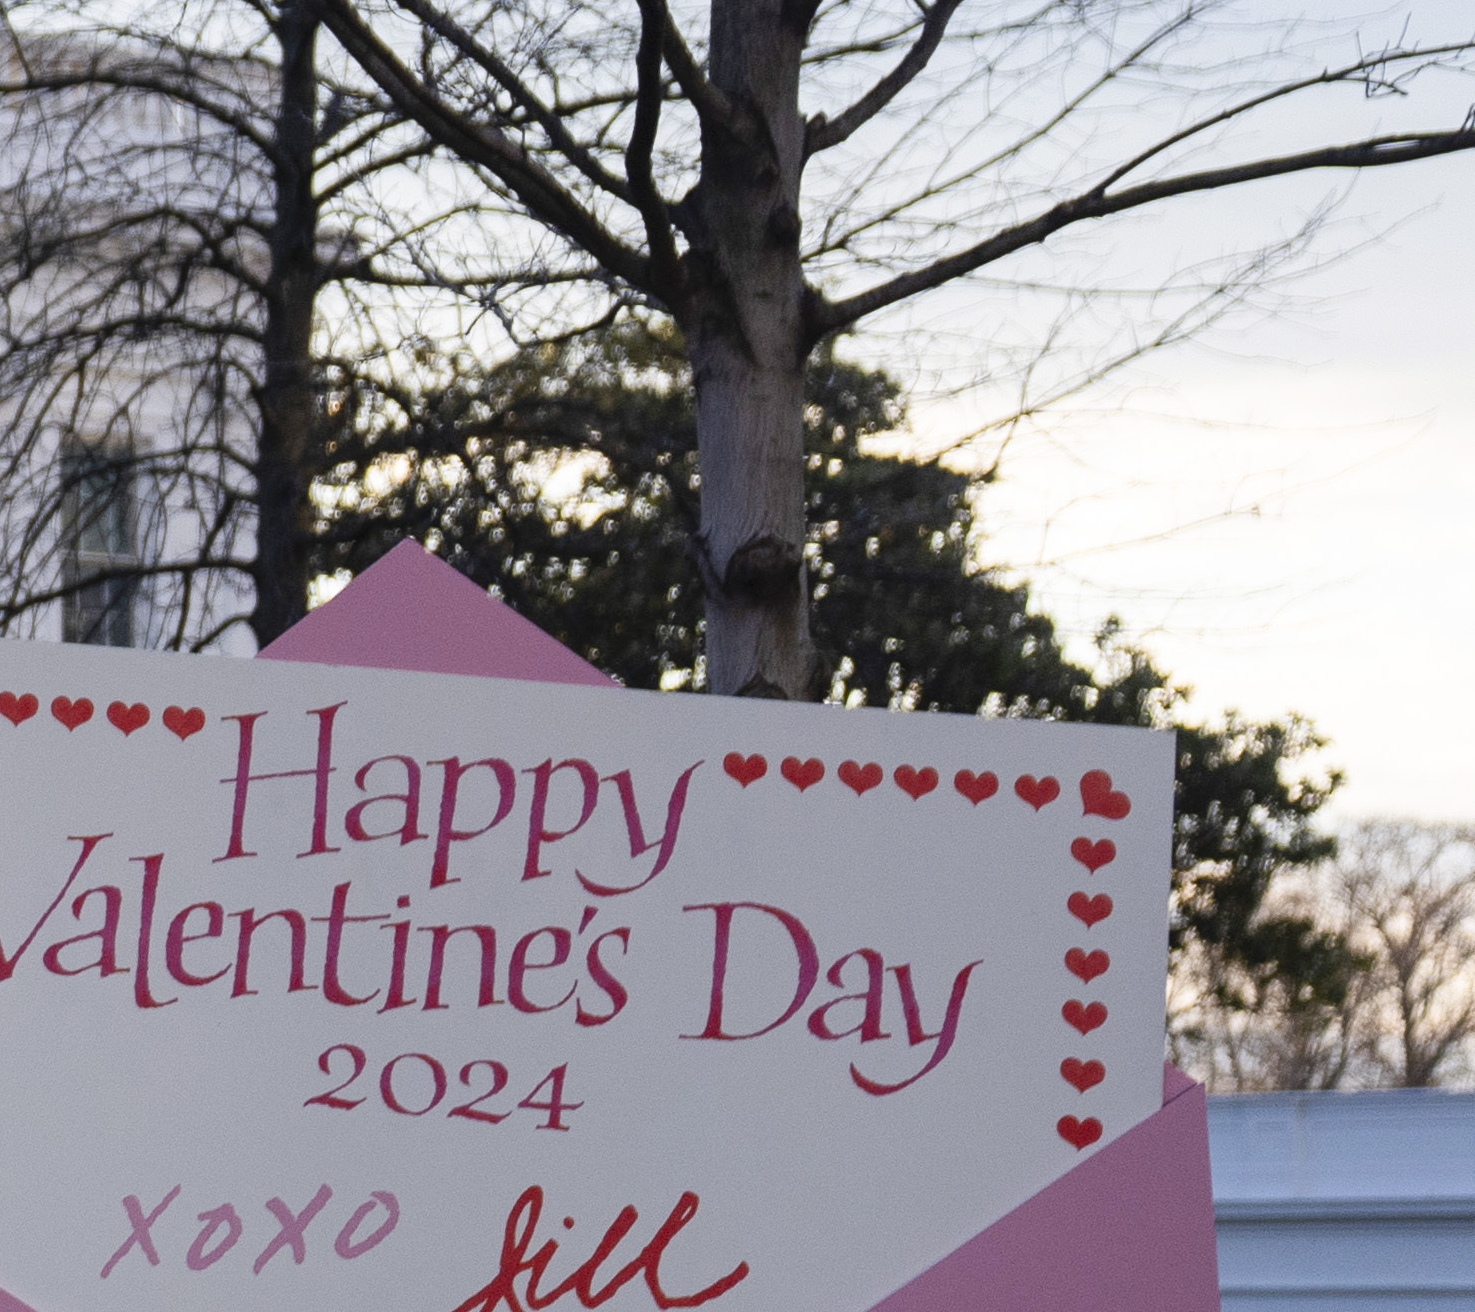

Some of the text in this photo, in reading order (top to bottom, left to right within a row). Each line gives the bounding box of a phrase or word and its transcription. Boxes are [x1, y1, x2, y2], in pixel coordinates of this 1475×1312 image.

[211, 700, 708, 897] Happy
[303, 1042, 583, 1133] 2024
[679, 901, 985, 1097] Day
